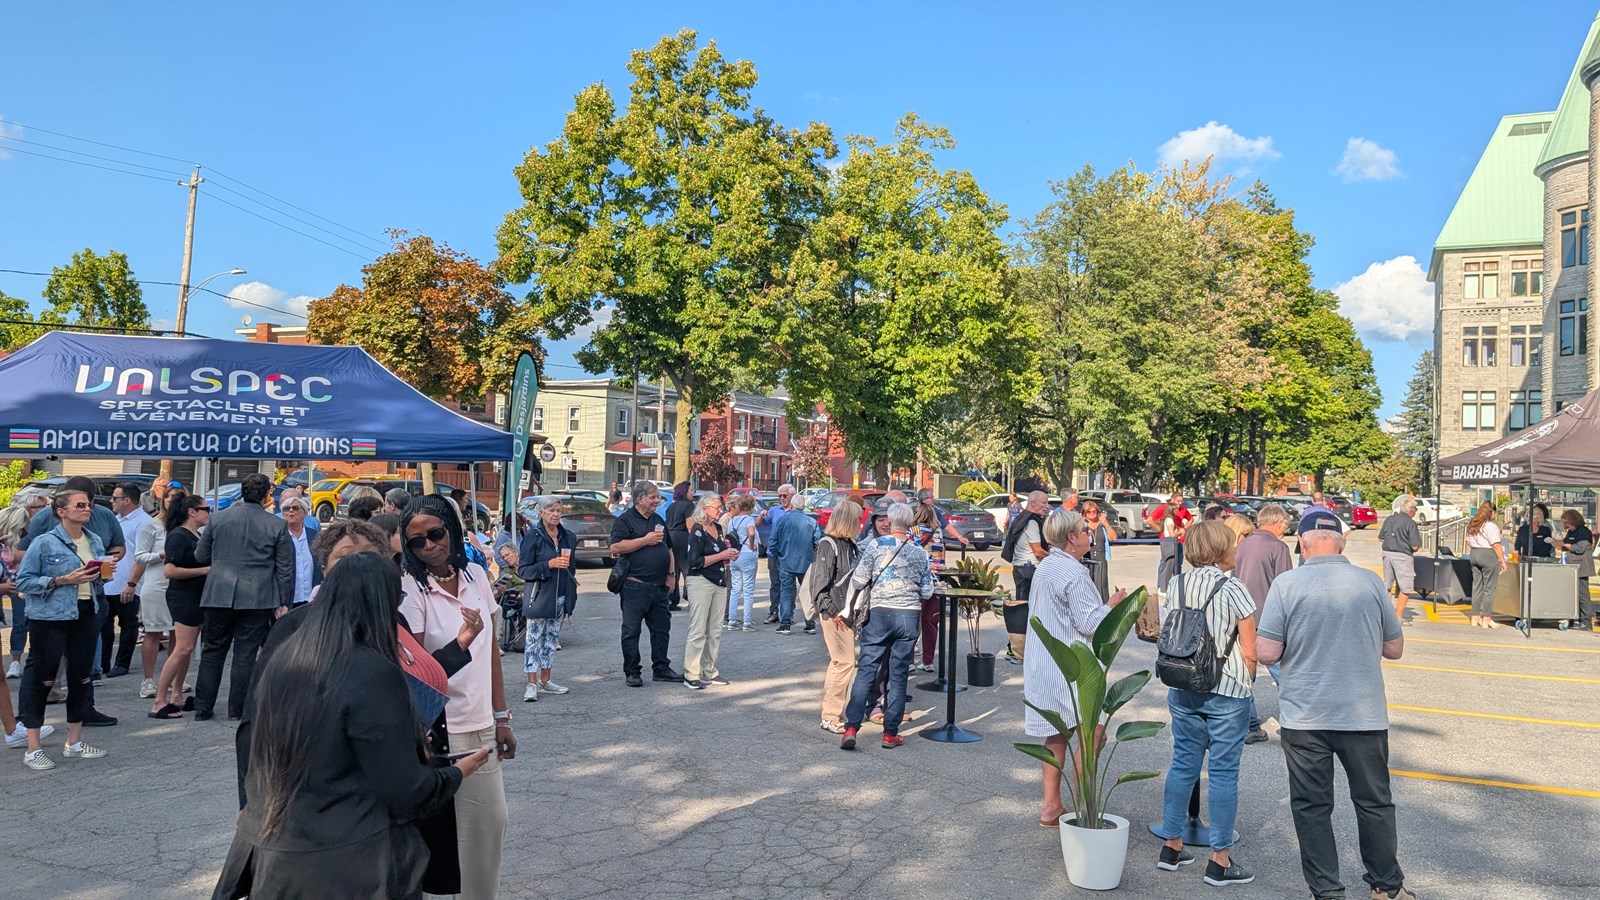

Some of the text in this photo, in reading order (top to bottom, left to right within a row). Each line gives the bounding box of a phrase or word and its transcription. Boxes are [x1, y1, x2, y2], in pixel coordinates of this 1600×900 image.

[99, 399, 310, 416] SPECTACLES ET
[516, 368, 530, 436] Desjardins
[110, 410, 298, 426] ÉVÉNEMENTS
[43, 429, 220, 453] AMPLIFICATEUR
